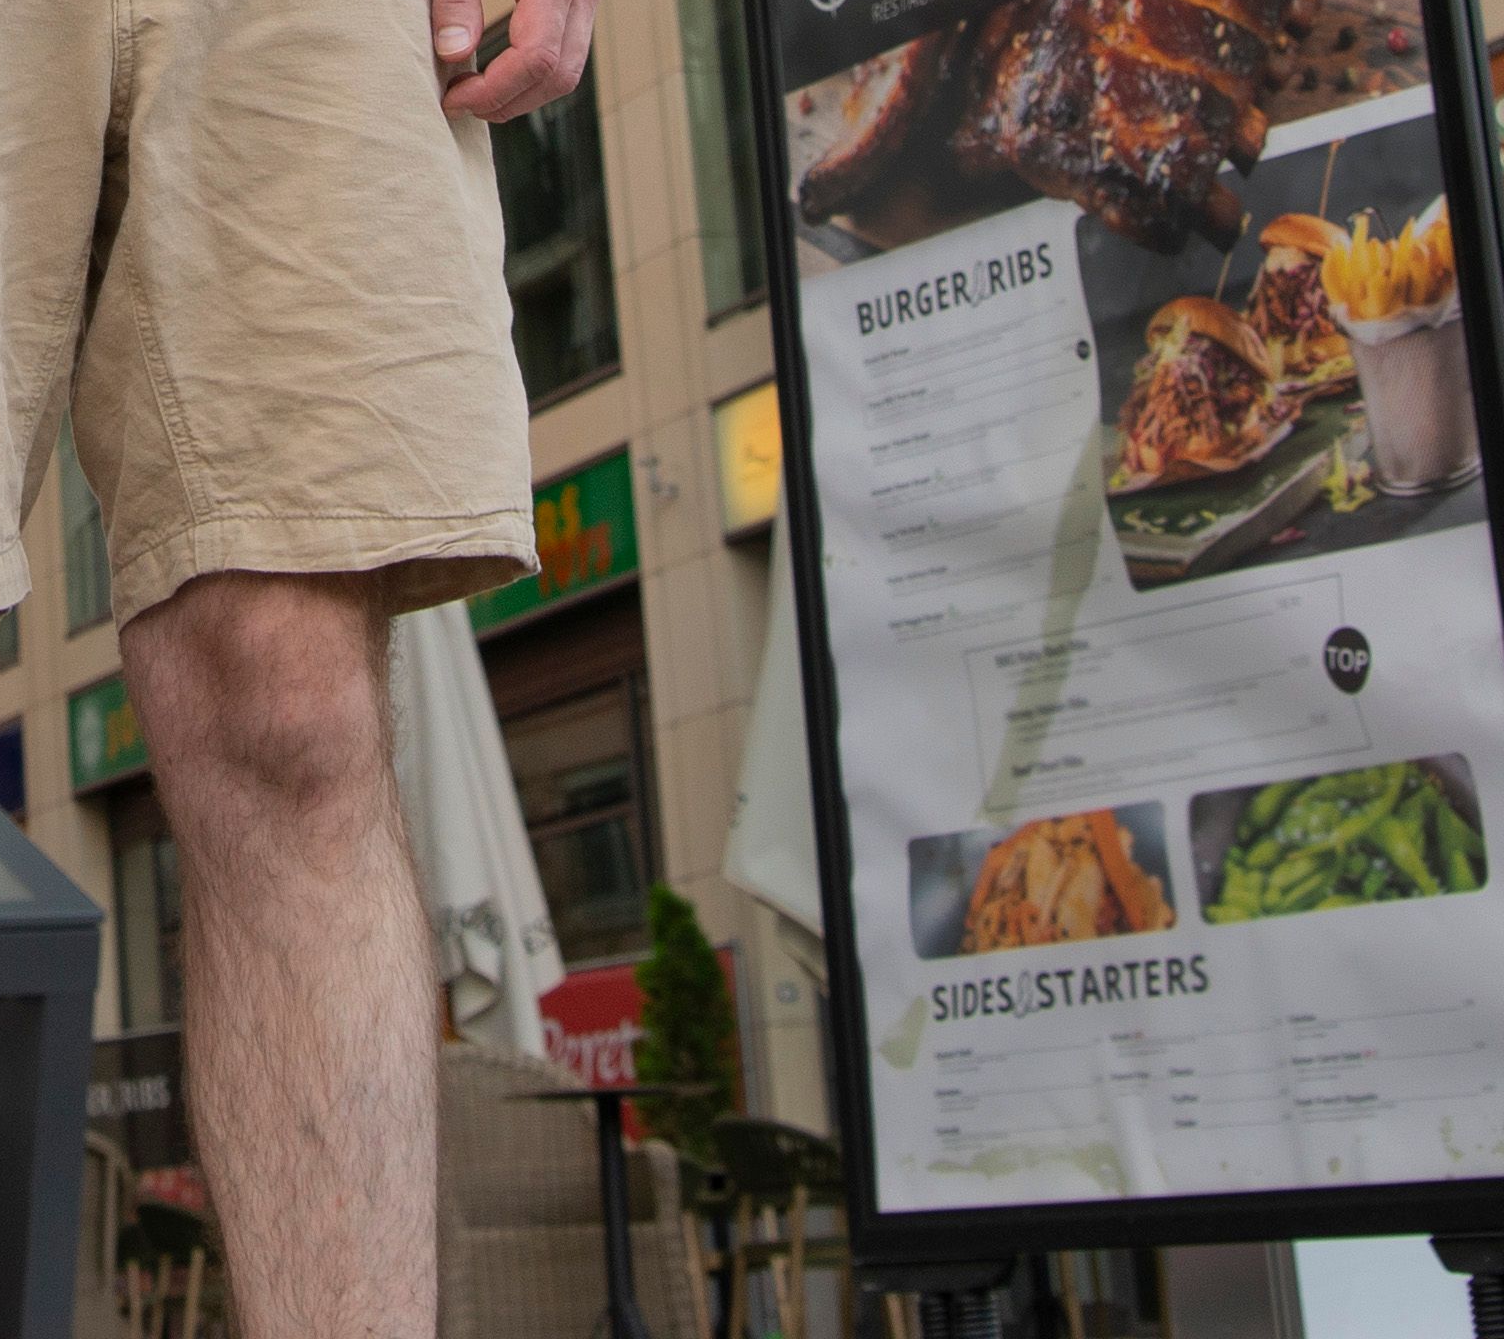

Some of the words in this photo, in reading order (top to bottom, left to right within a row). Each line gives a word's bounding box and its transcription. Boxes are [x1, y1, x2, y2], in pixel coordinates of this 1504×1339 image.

[856, 270, 972, 336] BURGER
[987, 242, 1054, 296] RIBS
[1327, 646, 1369, 673] TOP
[932, 976, 1015, 1022] SIDES
[1034, 953, 1211, 1010] STARTERS
